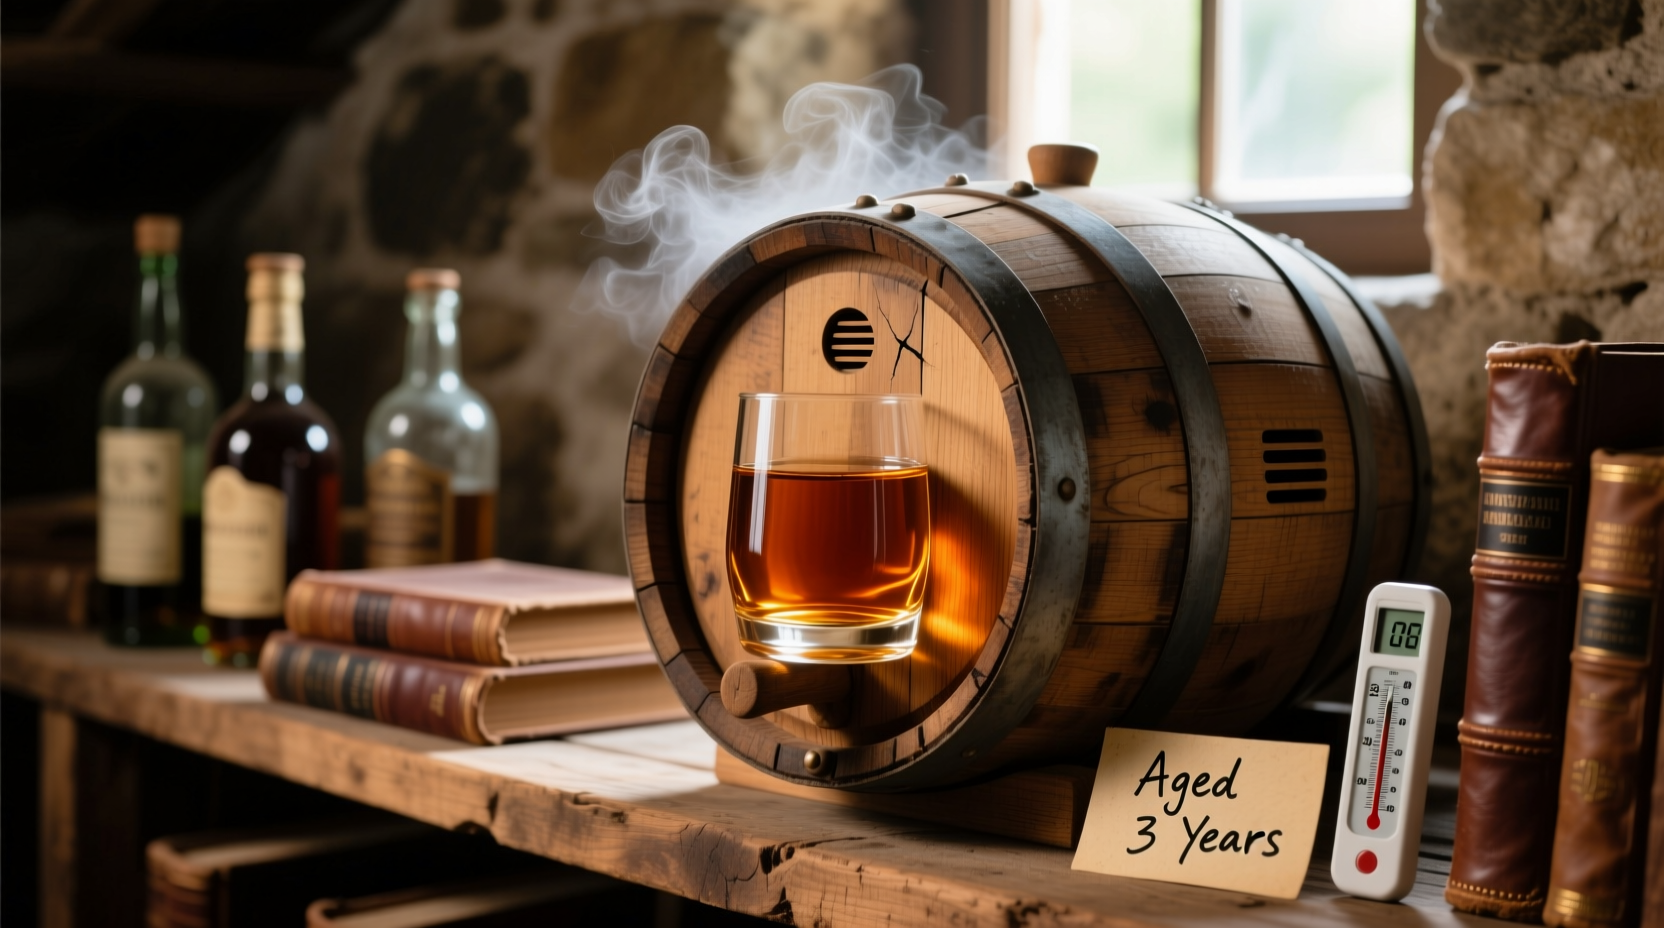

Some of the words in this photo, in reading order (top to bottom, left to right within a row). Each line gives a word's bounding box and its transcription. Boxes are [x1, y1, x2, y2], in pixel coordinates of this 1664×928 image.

[1389, 621, 1422, 650] 08
[1133, 749, 1242, 817] Aged
[1126, 815, 1157, 855] 3
[1178, 815, 1283, 865] Years
